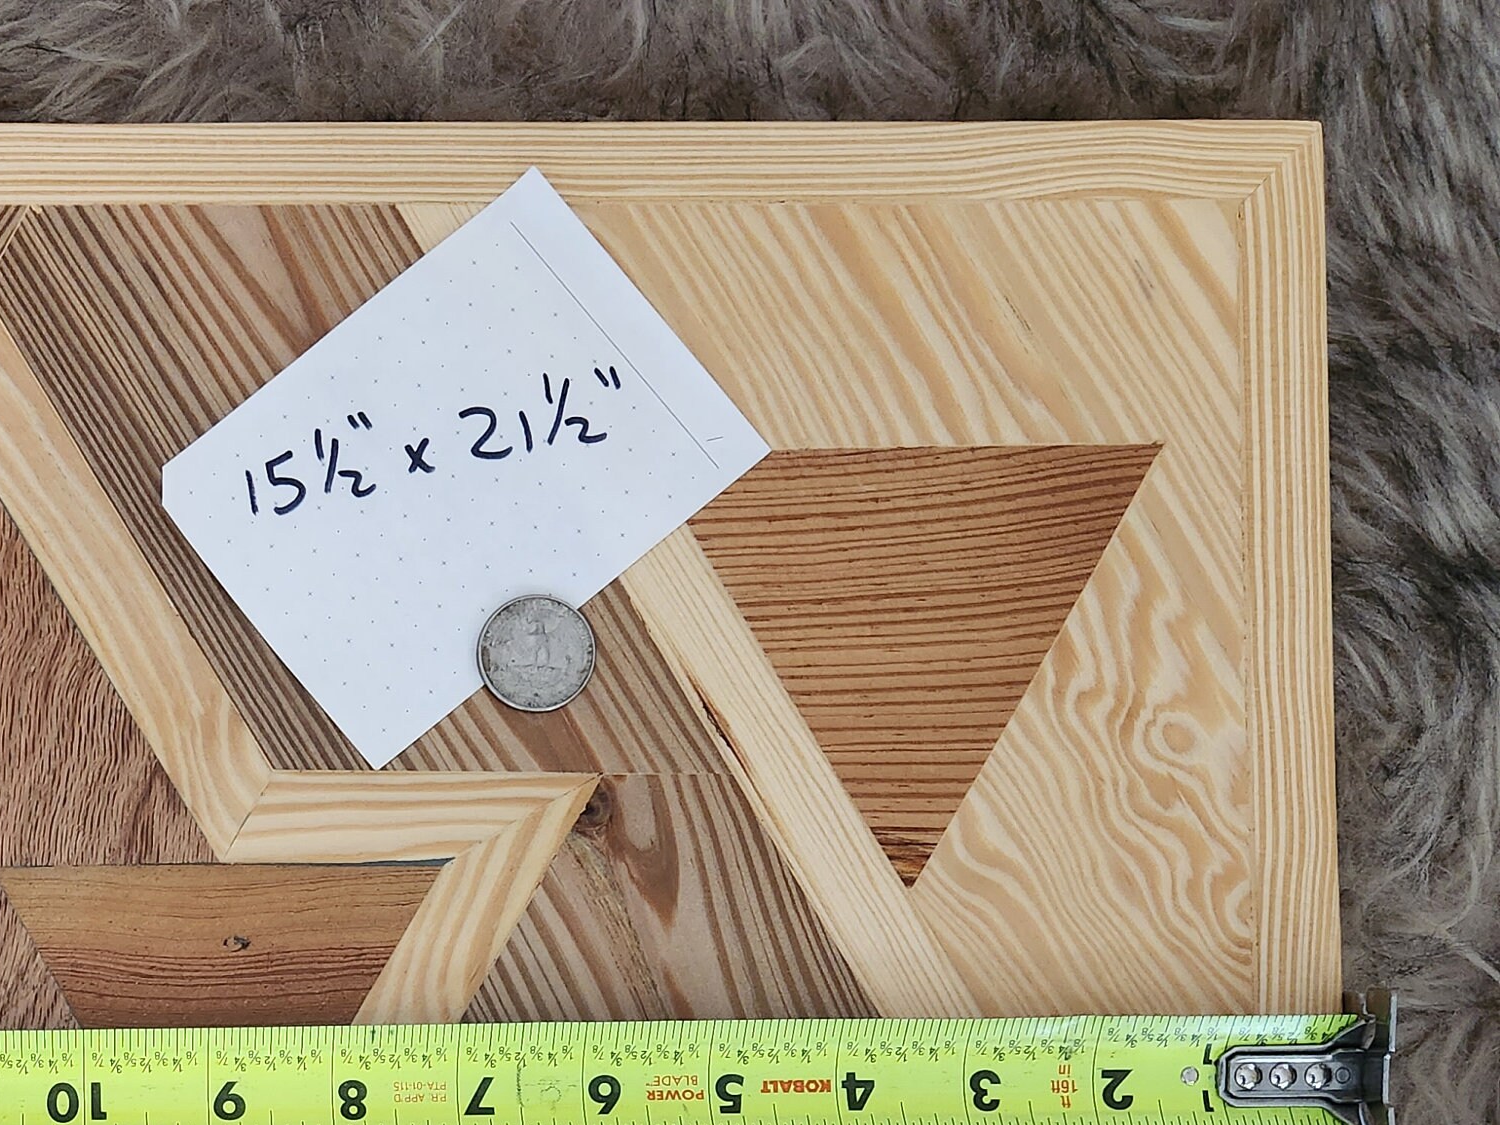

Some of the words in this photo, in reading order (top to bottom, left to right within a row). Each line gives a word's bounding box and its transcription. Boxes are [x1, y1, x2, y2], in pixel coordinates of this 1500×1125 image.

[393, 1081, 447, 1090] PTA-01-115
[760, 1079, 831, 1093] KOBALT
[1050, 1079, 1078, 1093] 16ft
[1058, 1064, 1071, 1077] in
[1101, 1069, 1134, 1110] 2
[47, 1082, 107, 1123] 10
[213, 1081, 246, 1120] 9
[338, 1080, 367, 1121] 8
[464, 1077, 495, 1116] 7
[588, 1075, 621, 1115] 6
[646, 1089, 704, 1101] POWER
[715, 1074, 744, 1114] 5
[841, 1071, 875, 1111] 4
[970, 1070, 1001, 1112] 3
[1060, 1096, 1071, 1109] ft
